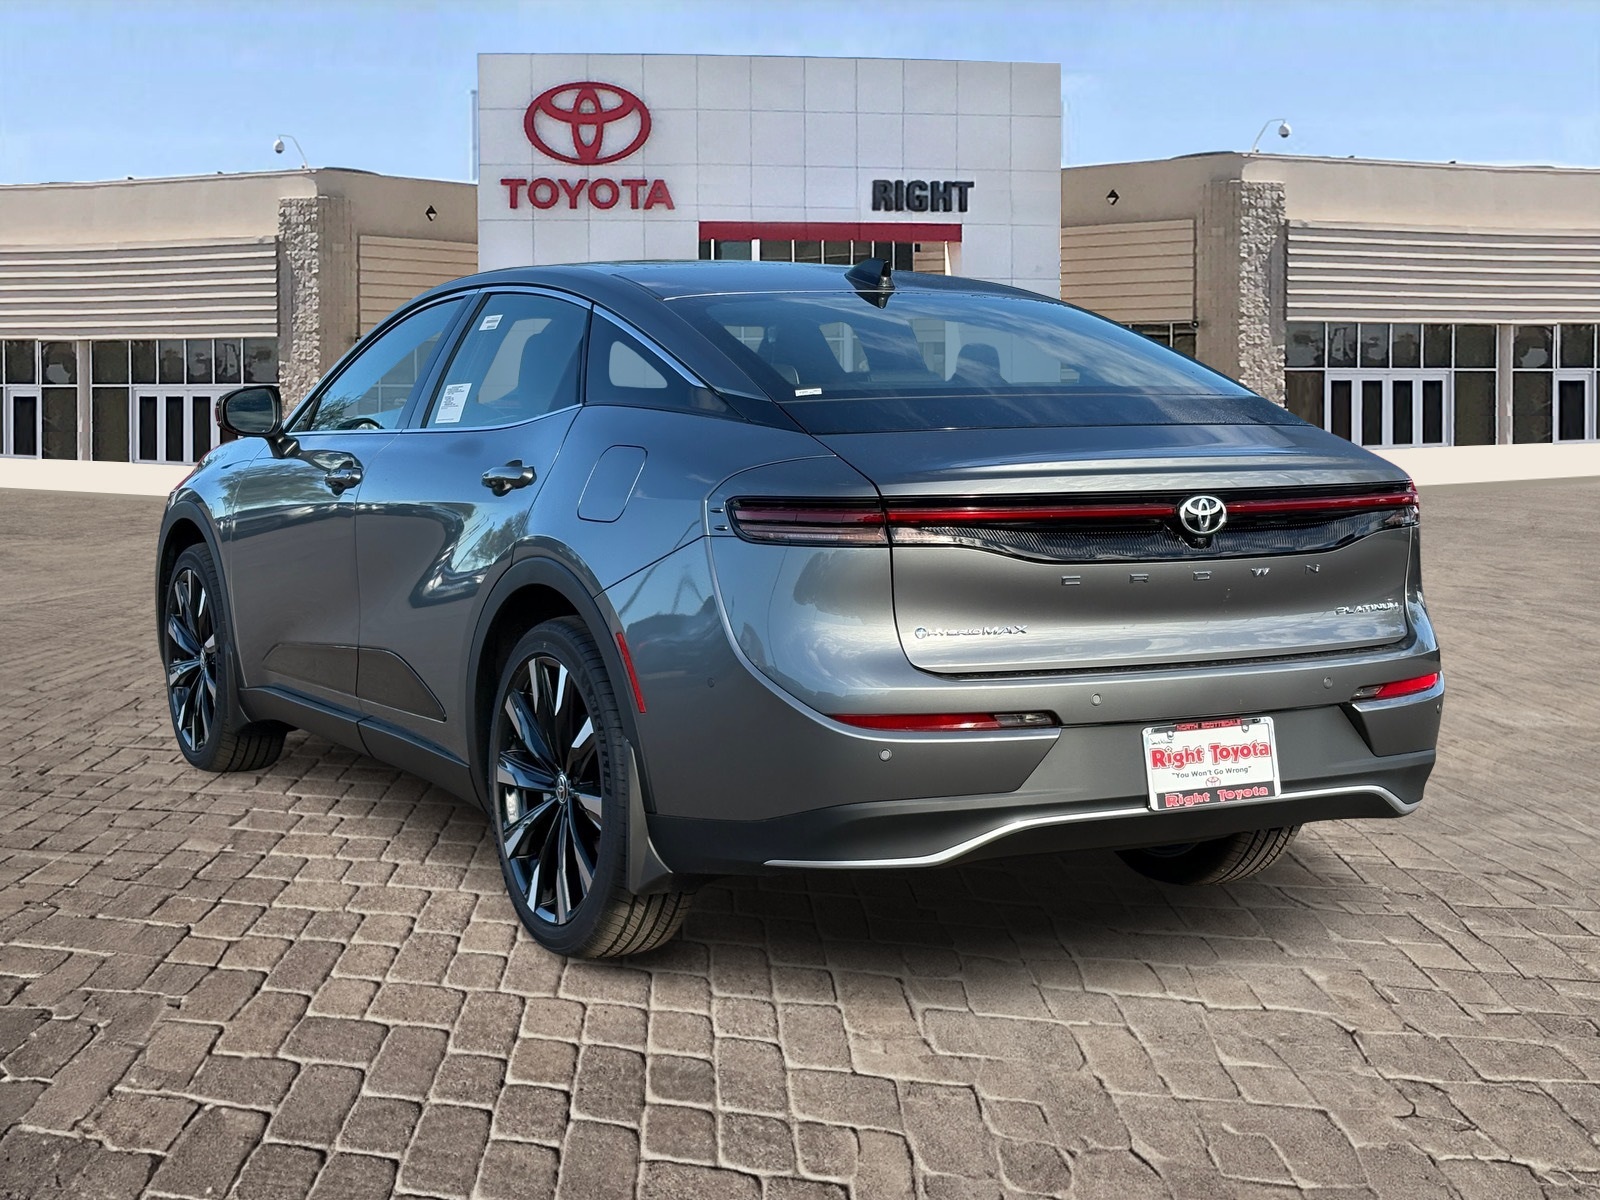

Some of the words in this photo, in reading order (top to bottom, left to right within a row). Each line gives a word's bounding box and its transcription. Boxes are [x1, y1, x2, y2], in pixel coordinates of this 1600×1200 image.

[500, 178, 675, 210] TOYOTA
[871, 179, 975, 213] RIGHT
[1061, 564, 1320, 586] CROWN
[1334, 602, 1399, 615] PLATINUM
[1149, 745, 1204, 769] Right
[1208, 740, 1272, 765] Toyota
[1165, 792, 1210, 808] Right
[1217, 786, 1268, 802] Toyota
